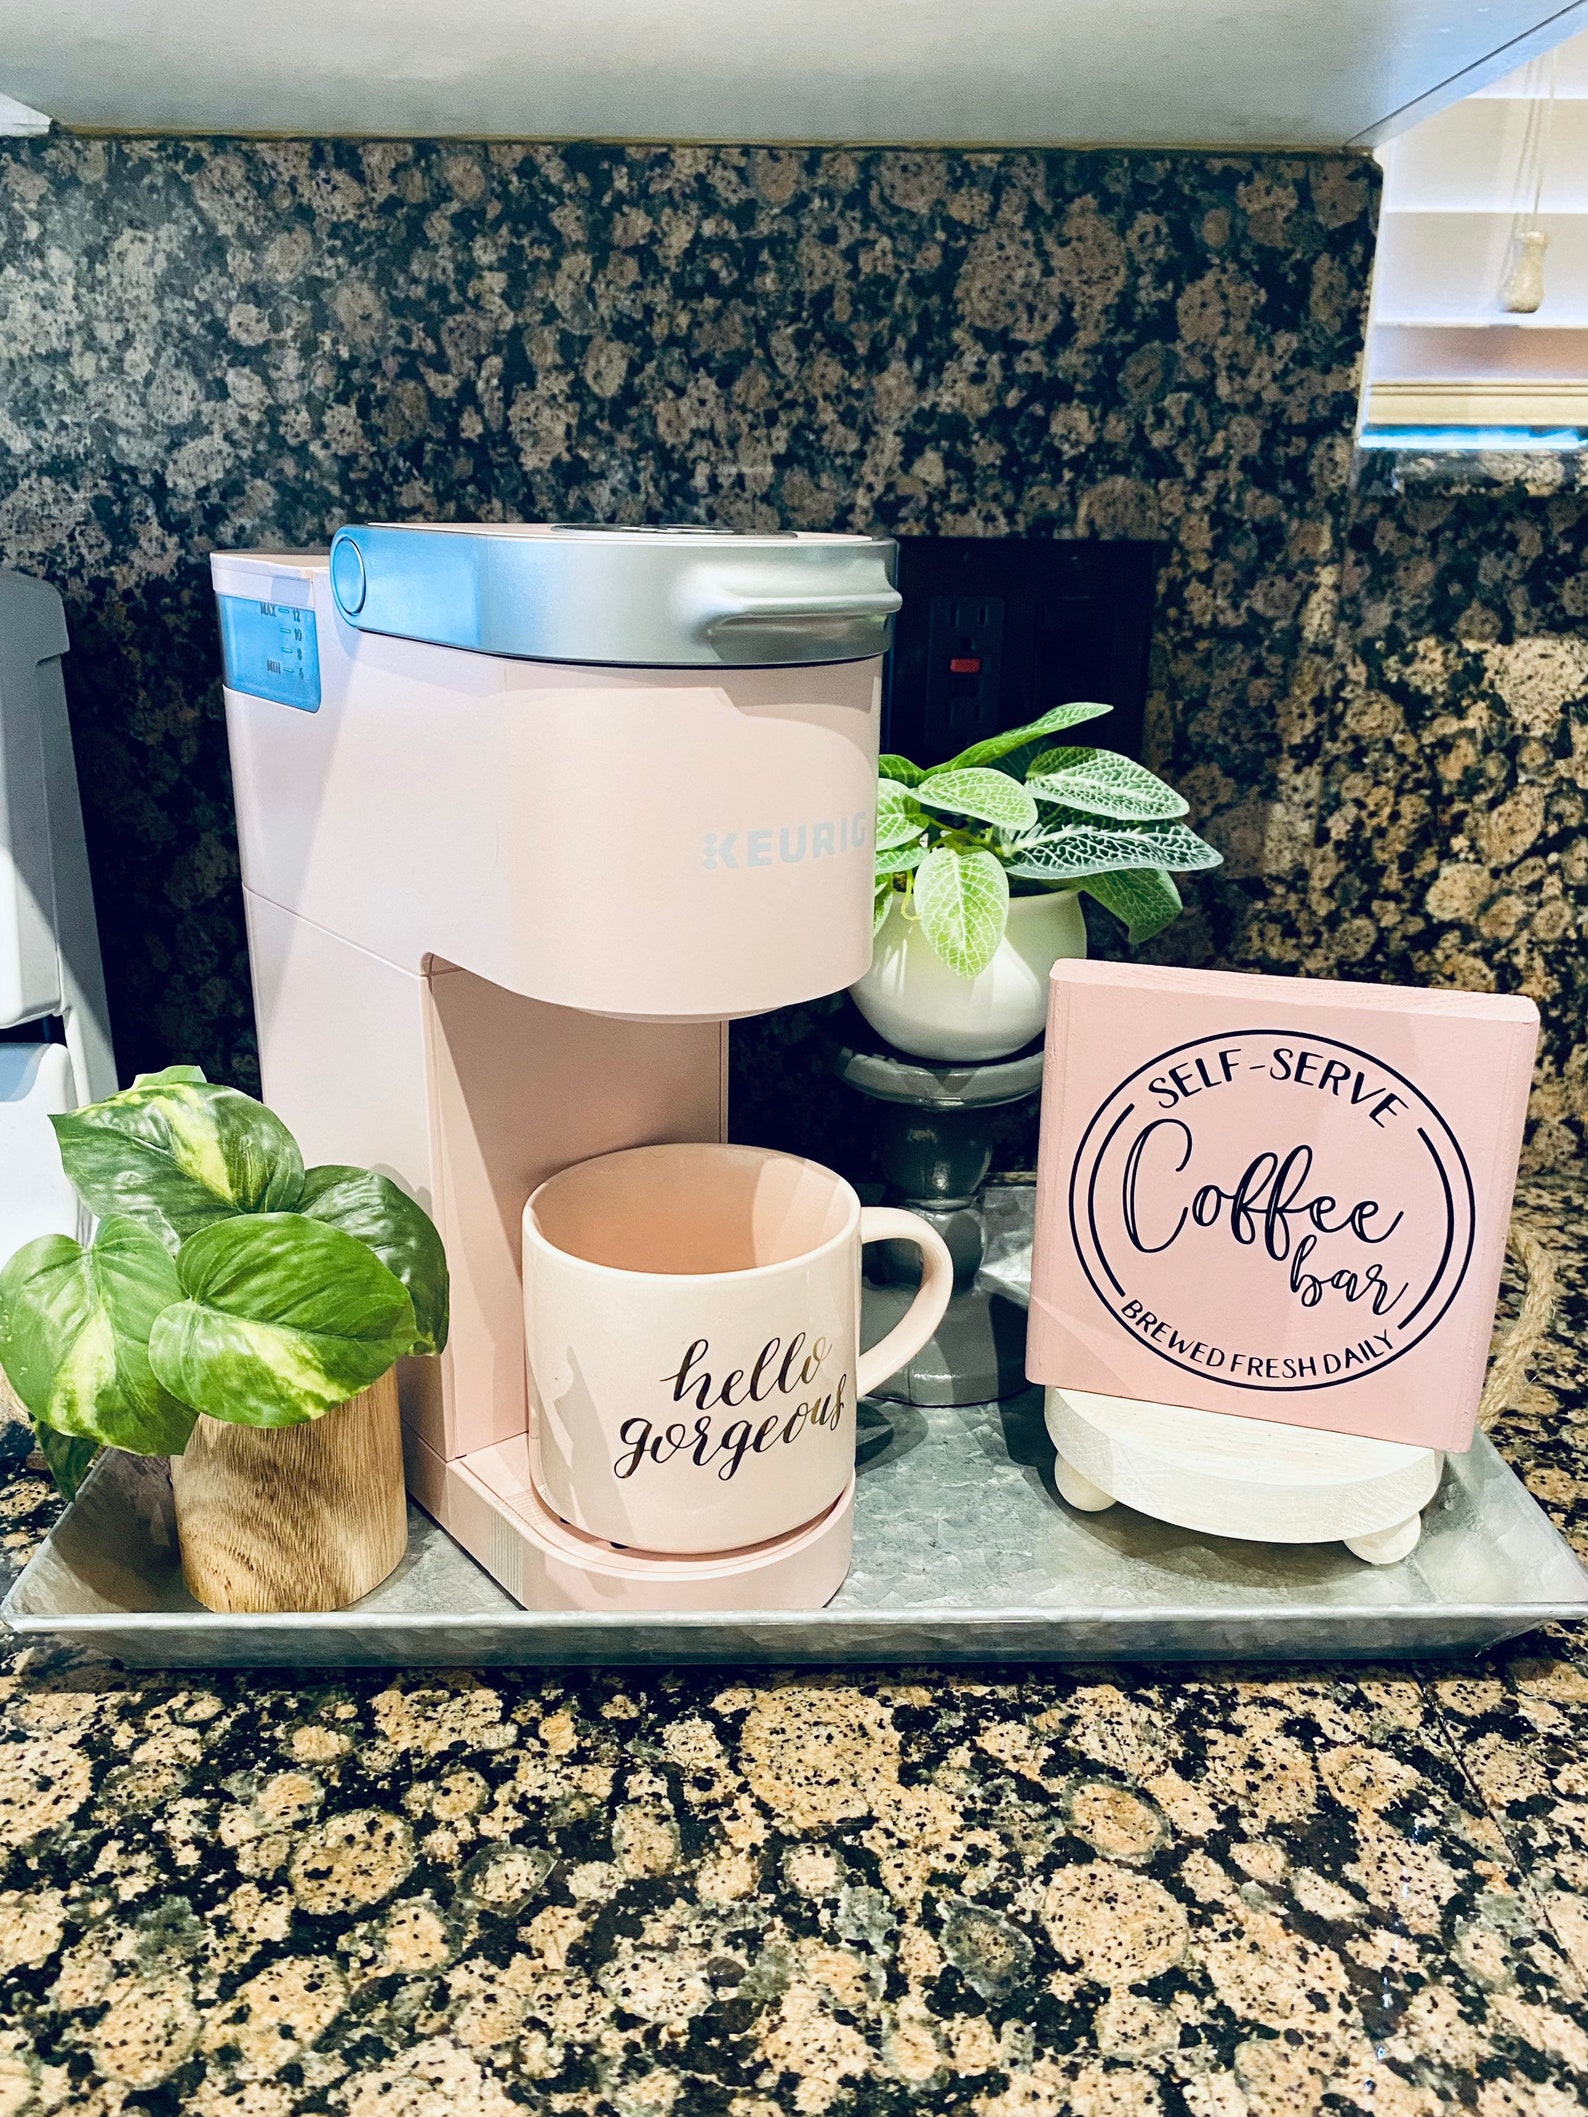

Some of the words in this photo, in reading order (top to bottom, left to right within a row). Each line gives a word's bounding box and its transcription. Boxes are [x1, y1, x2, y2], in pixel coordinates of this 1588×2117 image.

[260, 603, 276, 617] MAX
[292, 608, 301, 622] 12
[294, 628, 303, 642] 10
[266, 659, 281, 675] MIN
[297, 647, 303, 661] 8
[703, 811, 866, 870] KEURIG
[1148, 1048, 1409, 1128] SELF-SERVE
[1122, 1118, 1404, 1261] Coffee
[1290, 1234, 1408, 1315] bar
[659, 1332, 832, 1410] hello
[1121, 1299, 1225, 1368] BREWED
[1231, 1354, 1317, 1379] FRESH
[1323, 1329, 1394, 1375] DAILY
[614, 1373, 846, 1481] gorgeous
